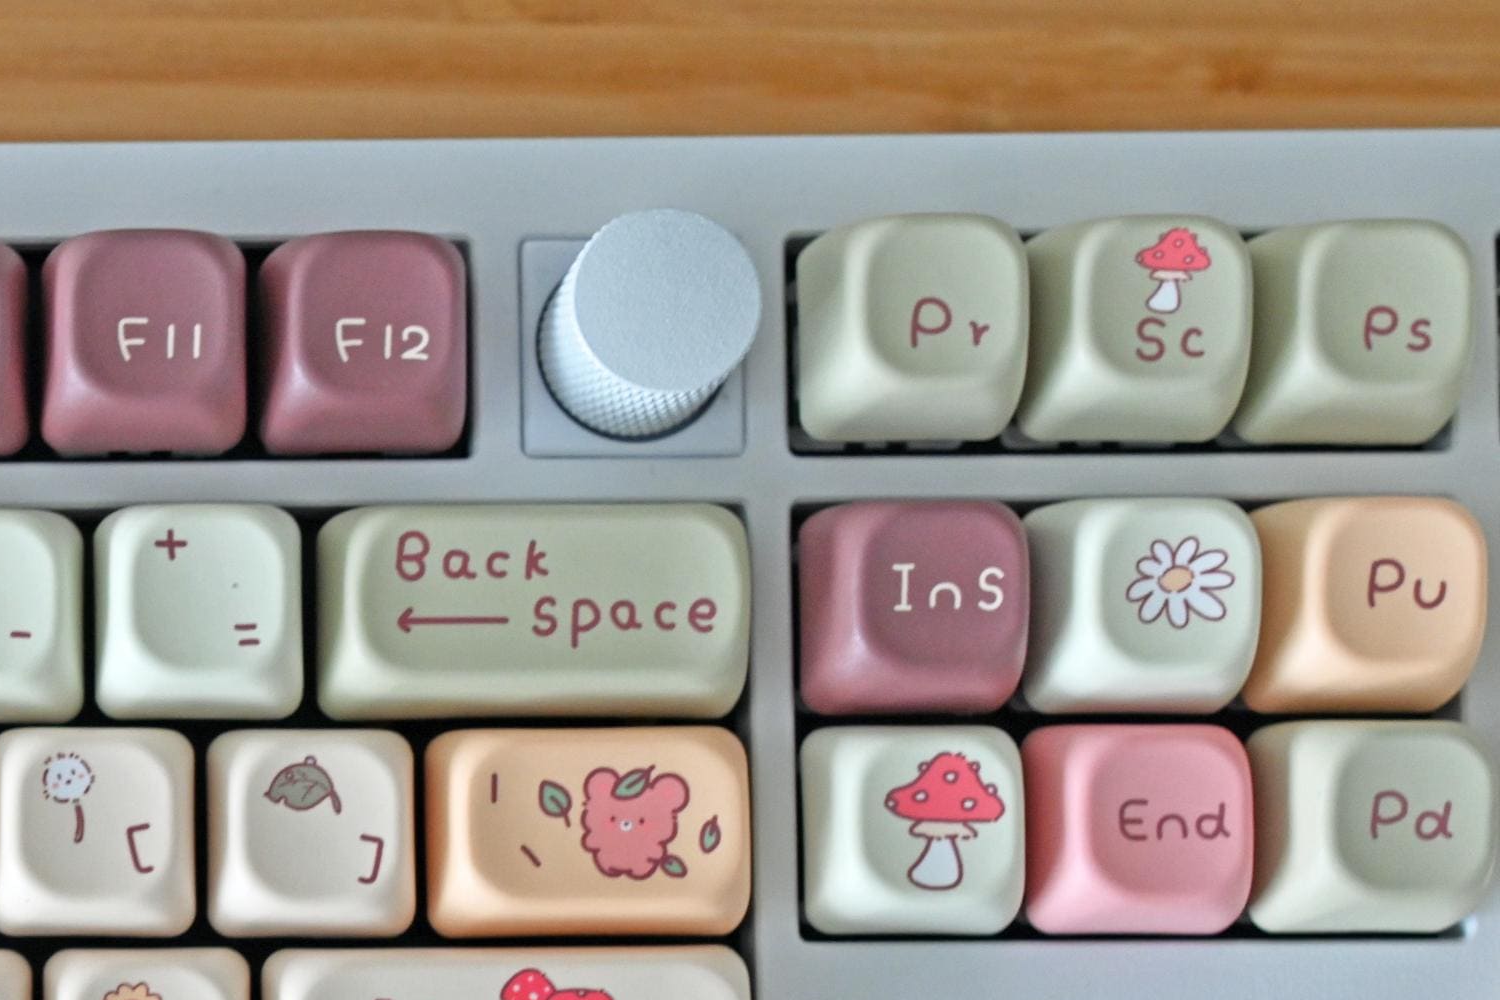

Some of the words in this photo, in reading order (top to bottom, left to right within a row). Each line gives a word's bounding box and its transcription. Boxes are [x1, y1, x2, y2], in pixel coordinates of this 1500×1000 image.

[118, 317, 201, 361] F11
[336, 318, 429, 362] F12
[911, 297, 990, 348] Pr
[1136, 317, 1205, 362] Sc
[1364, 306, 1431, 352] Ps
[154, 529, 188, 560] +
[396, 531, 548, 582] Back
[1368, 558, 1447, 609] Pu
[9, 630, 32, 639] -
[234, 624, 260, 646] =
[1119, 799, 1230, 841] End
[1371, 790, 1452, 840] Pd
[126, 823, 153, 873] [
[358, 834, 384, 884] ]
